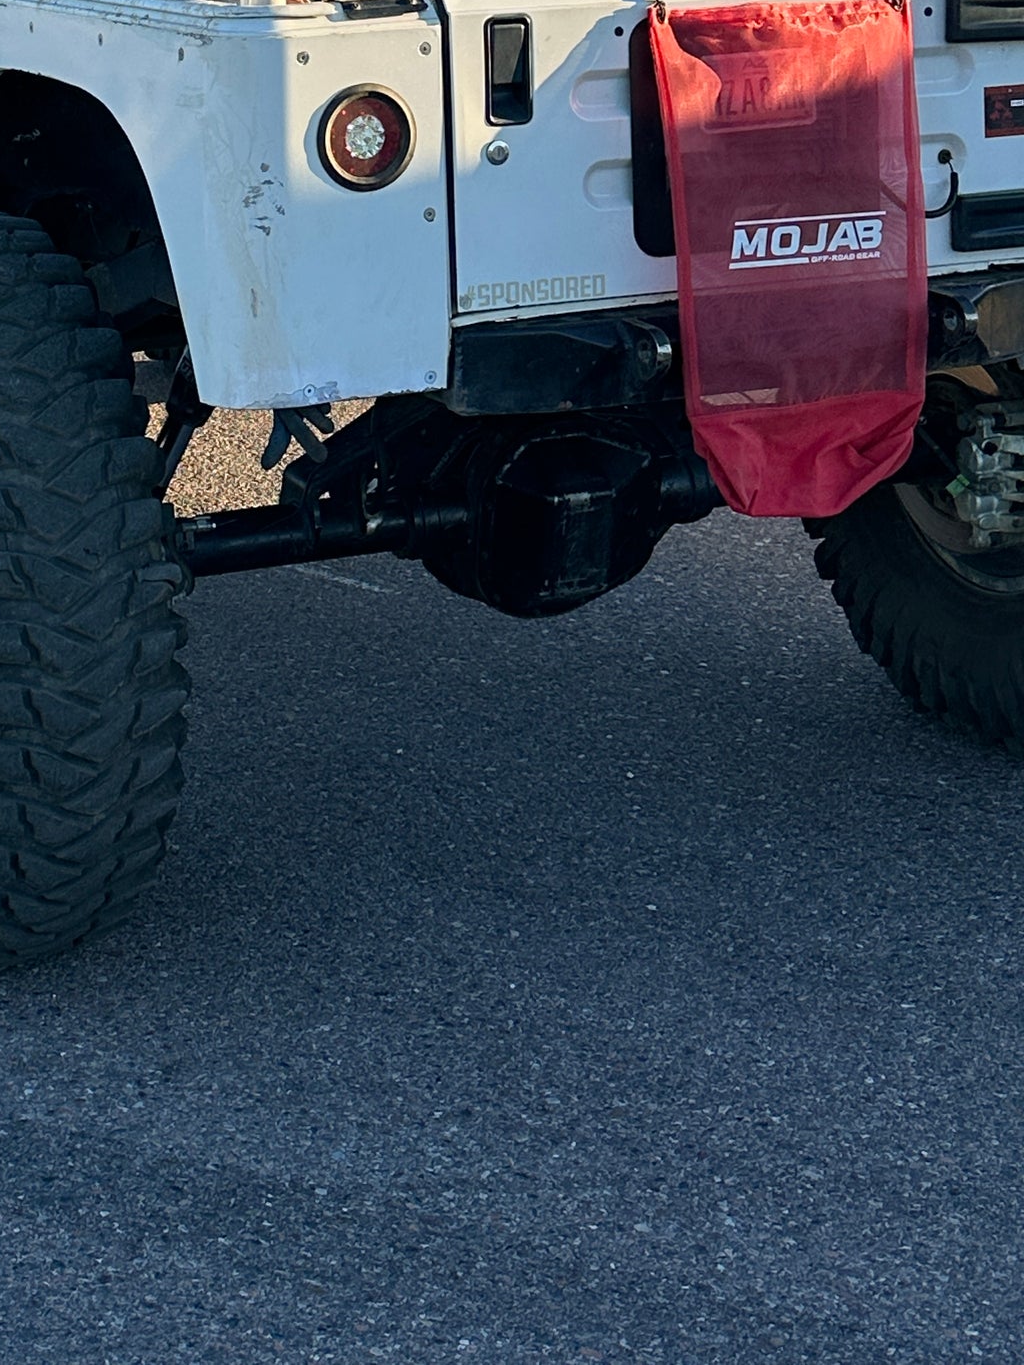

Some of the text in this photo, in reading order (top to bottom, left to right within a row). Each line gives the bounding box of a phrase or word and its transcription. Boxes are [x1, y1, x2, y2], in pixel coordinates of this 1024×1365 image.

[731, 219, 883, 259] MOJAB
[811, 251, 881, 263] OFF-ROAD GEAR
